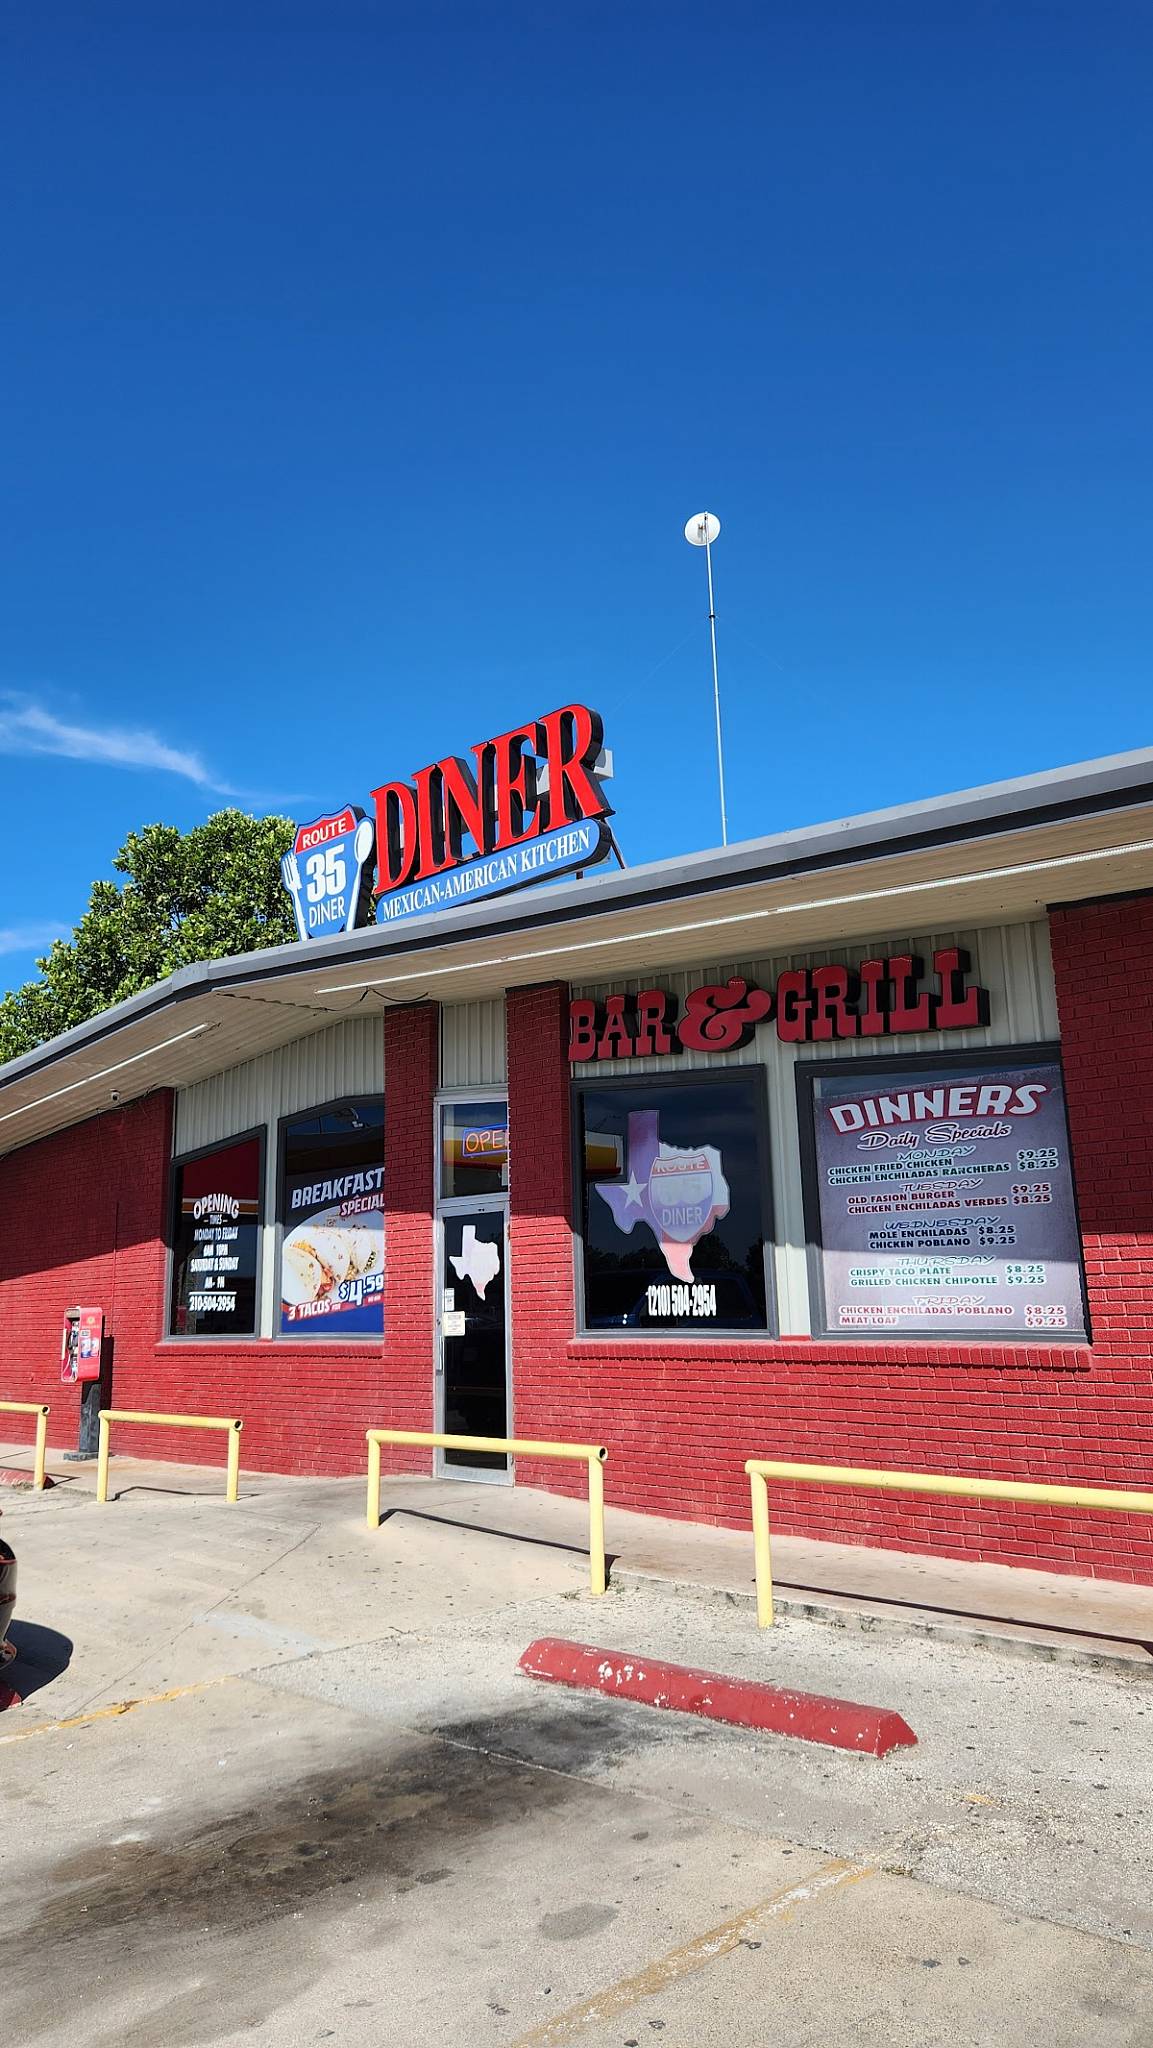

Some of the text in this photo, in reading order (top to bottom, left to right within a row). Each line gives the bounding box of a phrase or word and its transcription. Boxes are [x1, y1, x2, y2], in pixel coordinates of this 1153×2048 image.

[369, 703, 604, 894] DINER
[302, 818, 347, 849] ROUTE
[306, 843, 346, 903] 35
[383, 826, 591, 921] MEXICAN-AMERICAN KITCHEN
[309, 896, 346, 928] DINER
[568, 947, 981, 1062] BAR & GRILL
[829, 1084, 1047, 1133] DINNERS
[465, 1129, 509, 1152] OPE
[857, 1122, 1012, 1150] Daily Specials
[829, 1149, 1056, 1176] CHICKEN FRIED CHICKEN $9.25
[898, 1146, 975, 1160] MONDAY
[829, 1159, 1057, 1185] CHICKEN ENCHILADAS RANCHERAS $8.25
[291, 1167, 385, 1209] BREAKFAST
[848, 1183, 1050, 1205] OLD FASION BURGER $9.25
[903, 1179, 983, 1192] TUESDAY
[193, 1193, 240, 1220] OPENING
[848, 1194, 1051, 1214] CHICKEN ENCHILADAS VERDES $8.25
[662, 1206, 704, 1226] DINER
[885, 1216, 999, 1230] WEDNESDAY
[869, 1225, 1015, 1240] MOLE ENCHILADAS $8.25
[869, 1235, 1016, 1249] CHICKEN POBLANO $9.25
[850, 1264, 1045, 1277] CRISPY TACO PLATE $8.25
[897, 1255, 995, 1267] THURSDAY
[850, 1275, 1046, 1287] GRILLED CHICKEN CHIPOTLE $9.25
[189, 1295, 236, 1312] 210-504-2954
[288, 1306, 297, 1321] 3
[298, 1299, 331, 1318] TACOS
[671, 1284, 717, 1317] 504-2954
[840, 1306, 1065, 1316] CHICKEN ENCHILADAS POBLANO $8.25
[914, 1296, 985, 1305] FRIDAY
[841, 1316, 1066, 1327] MEAT LOAF $9.25
